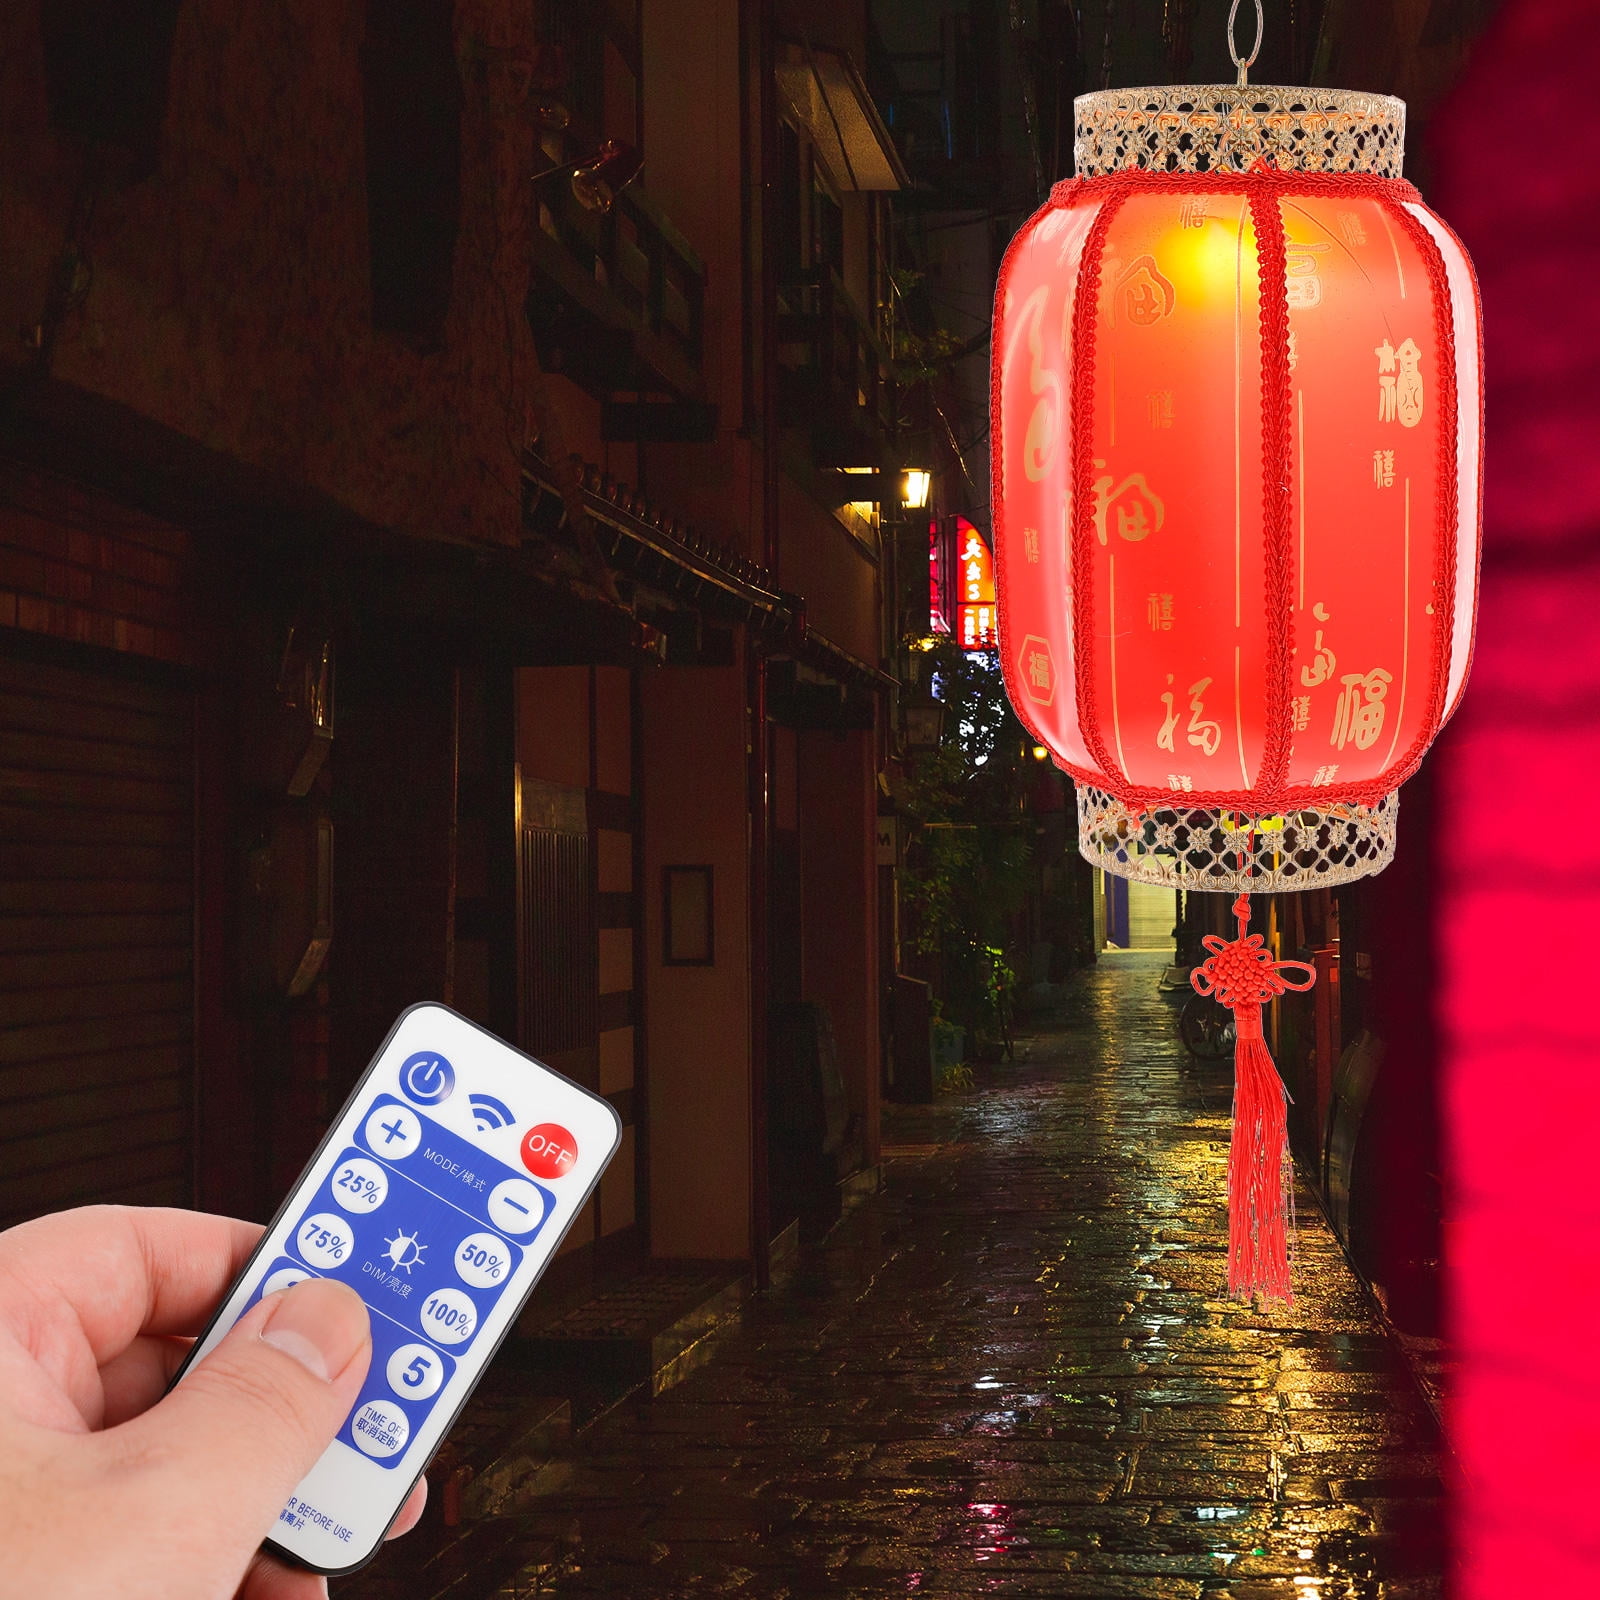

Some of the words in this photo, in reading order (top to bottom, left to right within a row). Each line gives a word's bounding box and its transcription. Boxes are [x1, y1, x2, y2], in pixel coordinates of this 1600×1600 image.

[1157, 673, 1221, 757] 福
[1330, 668, 1393, 751] 福
[528, 1134, 573, 1167] OFF
[337, 1169, 378, 1205] 25%
[423, 1147, 487, 1193] MODE/模式
[303, 1223, 345, 1261] 75%
[361, 1260, 414, 1300] DIM/亮度
[461, 1245, 502, 1280] 50%
[426, 1298, 473, 1337] 100%
[402, 1356, 432, 1388] 5
[355, 1417, 400, 1450] 取消定时
[364, 1406, 387, 1427] TIME
[387, 1421, 406, 1438] OFF
[287, 1496, 298, 1509] R
[297, 1502, 333, 1531] BEFORE
[333, 1524, 353, 1543] USE
